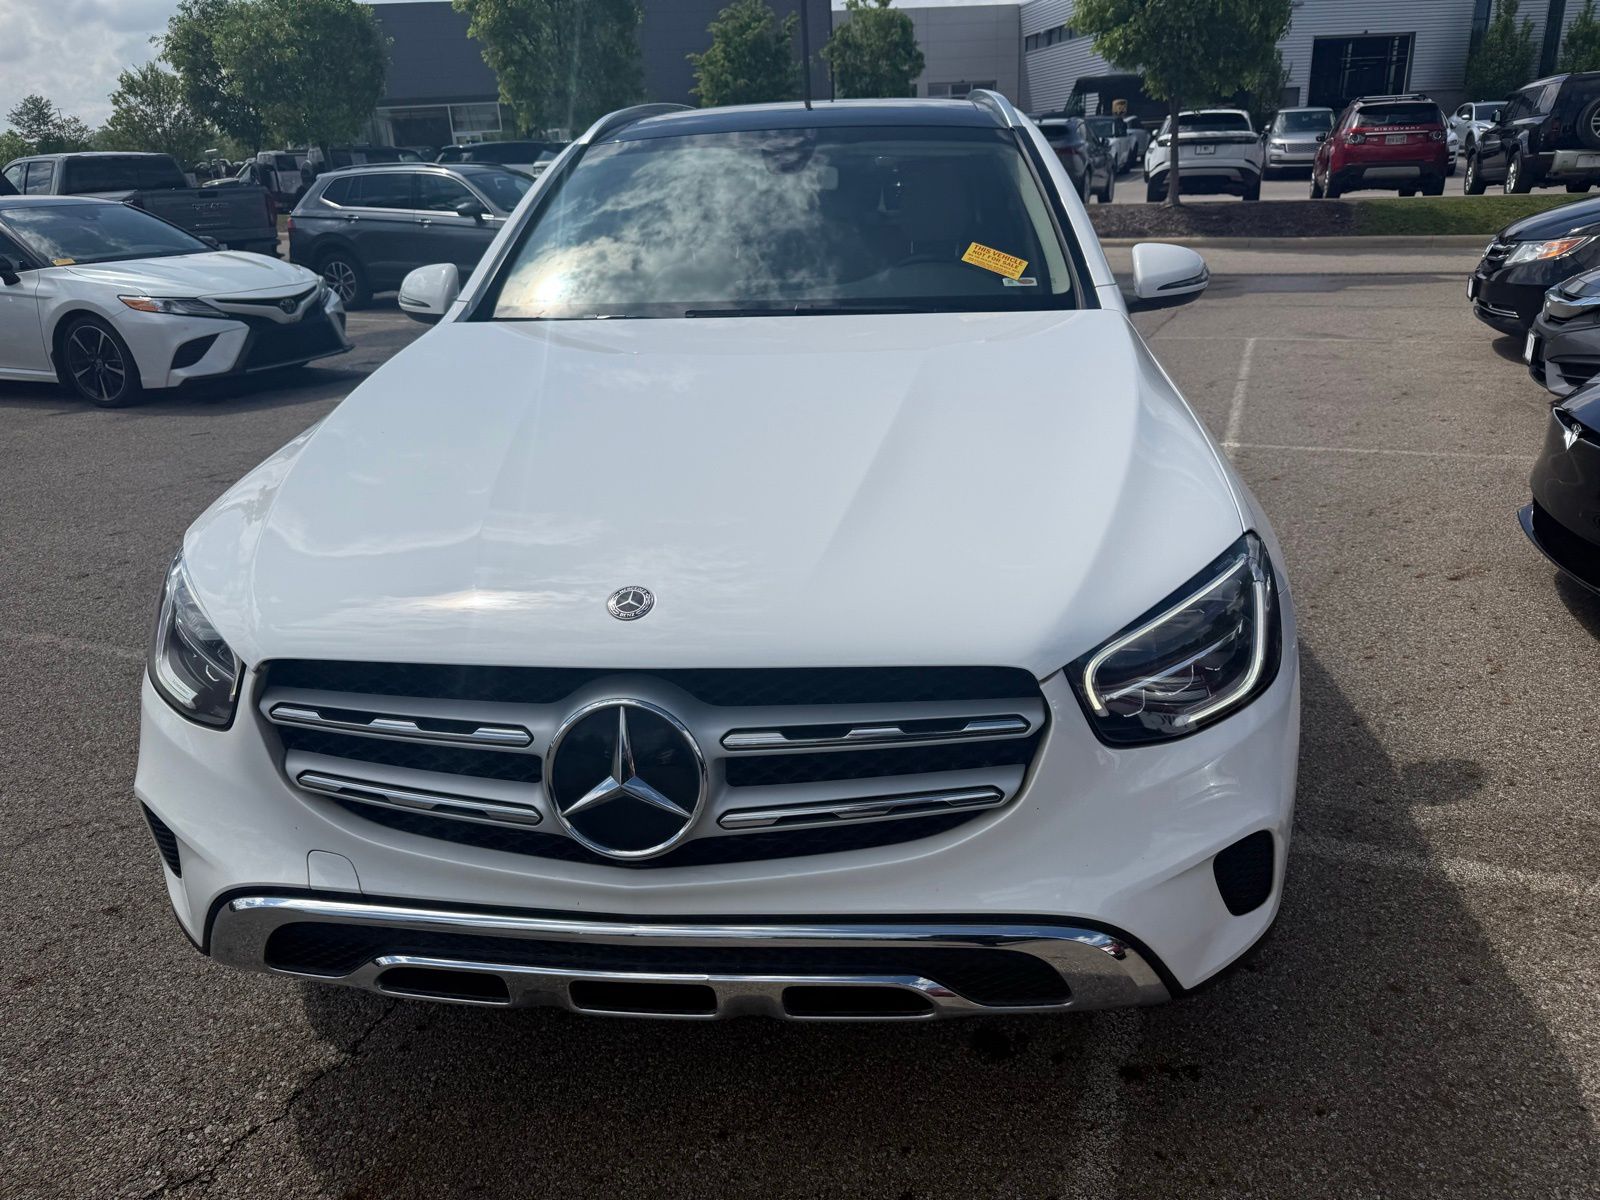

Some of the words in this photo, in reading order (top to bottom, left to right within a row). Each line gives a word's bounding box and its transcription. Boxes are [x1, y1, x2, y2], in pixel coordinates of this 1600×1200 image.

[972, 250, 986, 258] NOT
[987, 254, 1001, 263] FOR
[1003, 260, 1020, 269] SALE
[974, 244, 992, 255] THIS
[993, 251, 1024, 266] VEHICLE
